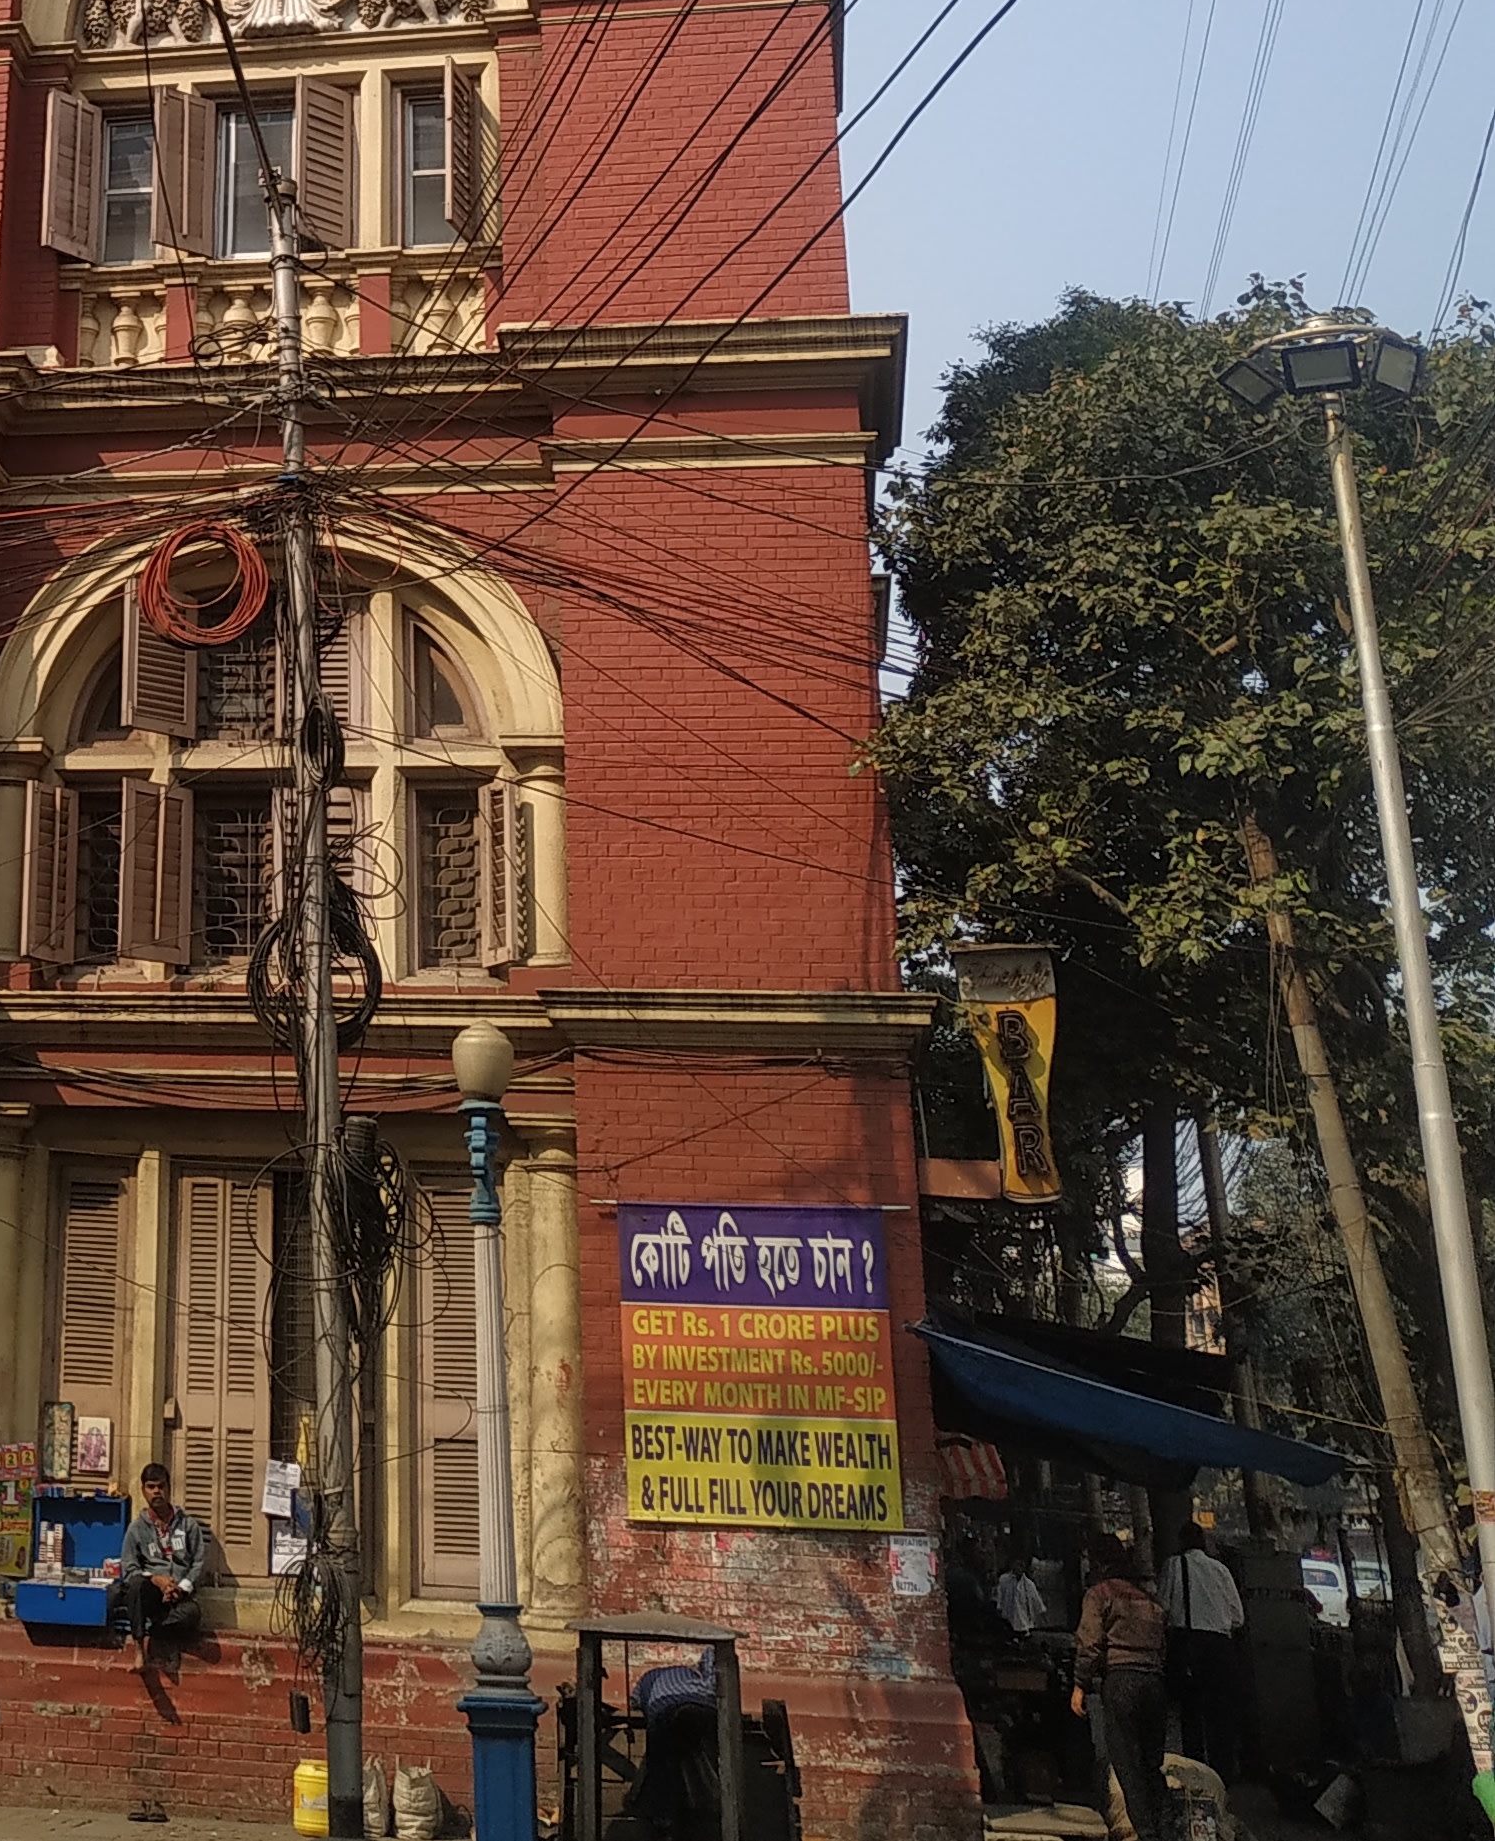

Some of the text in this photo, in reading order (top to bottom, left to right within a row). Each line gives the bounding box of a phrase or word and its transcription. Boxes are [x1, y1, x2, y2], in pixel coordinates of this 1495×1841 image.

[996, 1010, 1050, 1176] BAR
[631, 1210, 873, 1298] কোটি পতি হতে চান ?
[632, 1310, 880, 1342] GET Rs. 1 CRORE PLUS
[632, 1344, 884, 1378] BY INVESTMENT Rs. 5000/-
[633, 1379, 887, 1413] EVERY MONTH IN MF-SIP
[631, 1424, 892, 1470] BEST-WAY TO MAKE WEALTH
[641, 1474, 888, 1522] & FULL FILL YOUR DREAMS
